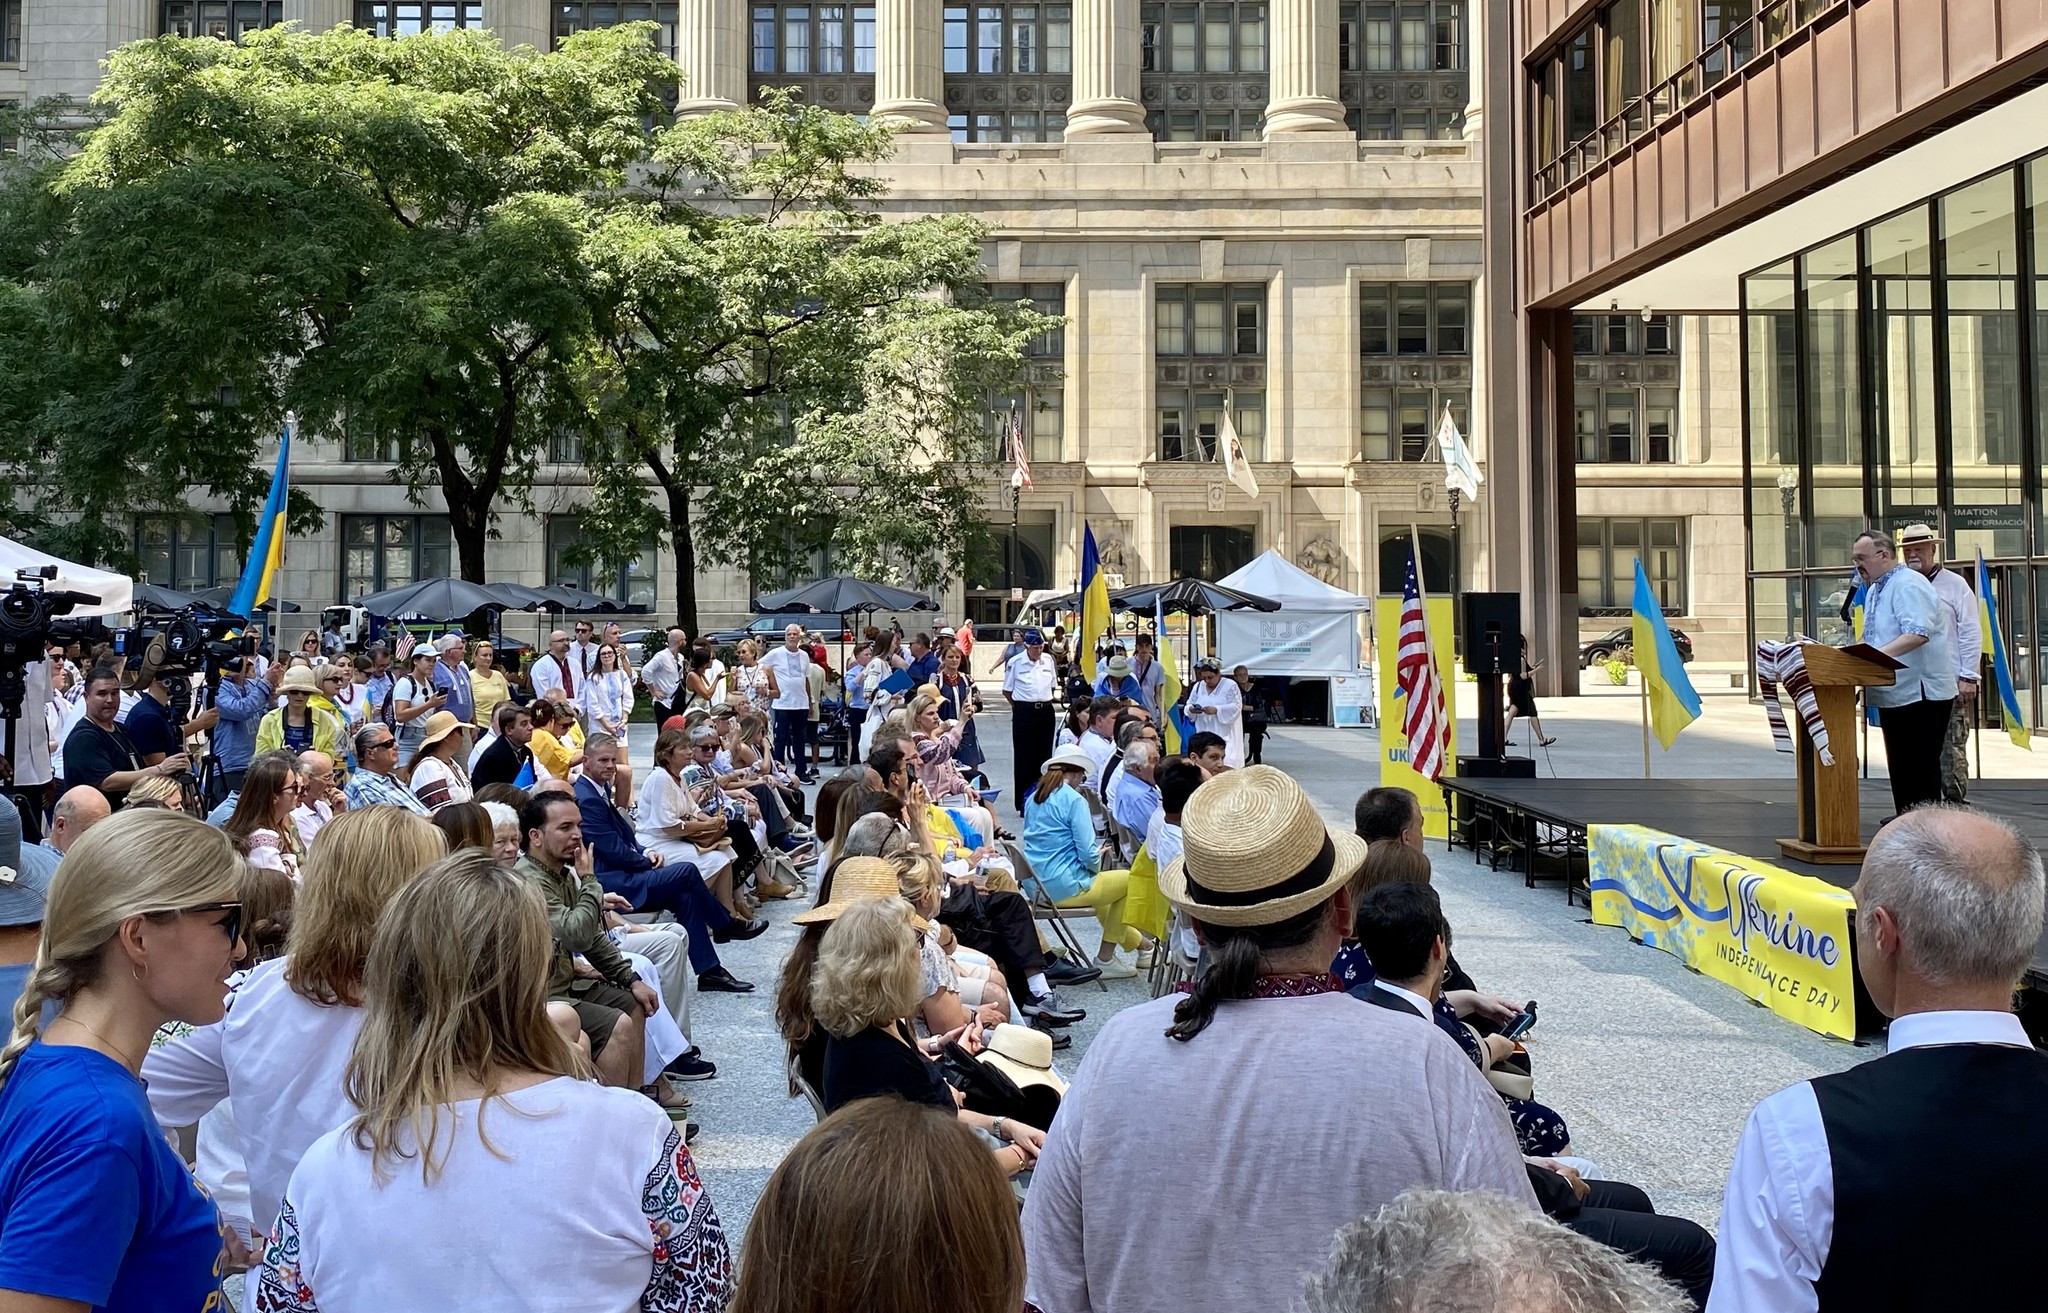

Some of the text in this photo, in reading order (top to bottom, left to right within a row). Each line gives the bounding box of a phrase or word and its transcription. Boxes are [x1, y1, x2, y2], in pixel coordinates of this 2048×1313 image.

[1924, 508, 1998, 516] INRMATION
[1967, 518, 2024, 526] INFORMACIÓ
[1260, 620, 1312, 638] NJC
[172, 637, 183, 649] 9
[1716, 942, 1841, 1013] INDEPENNCE DAY
